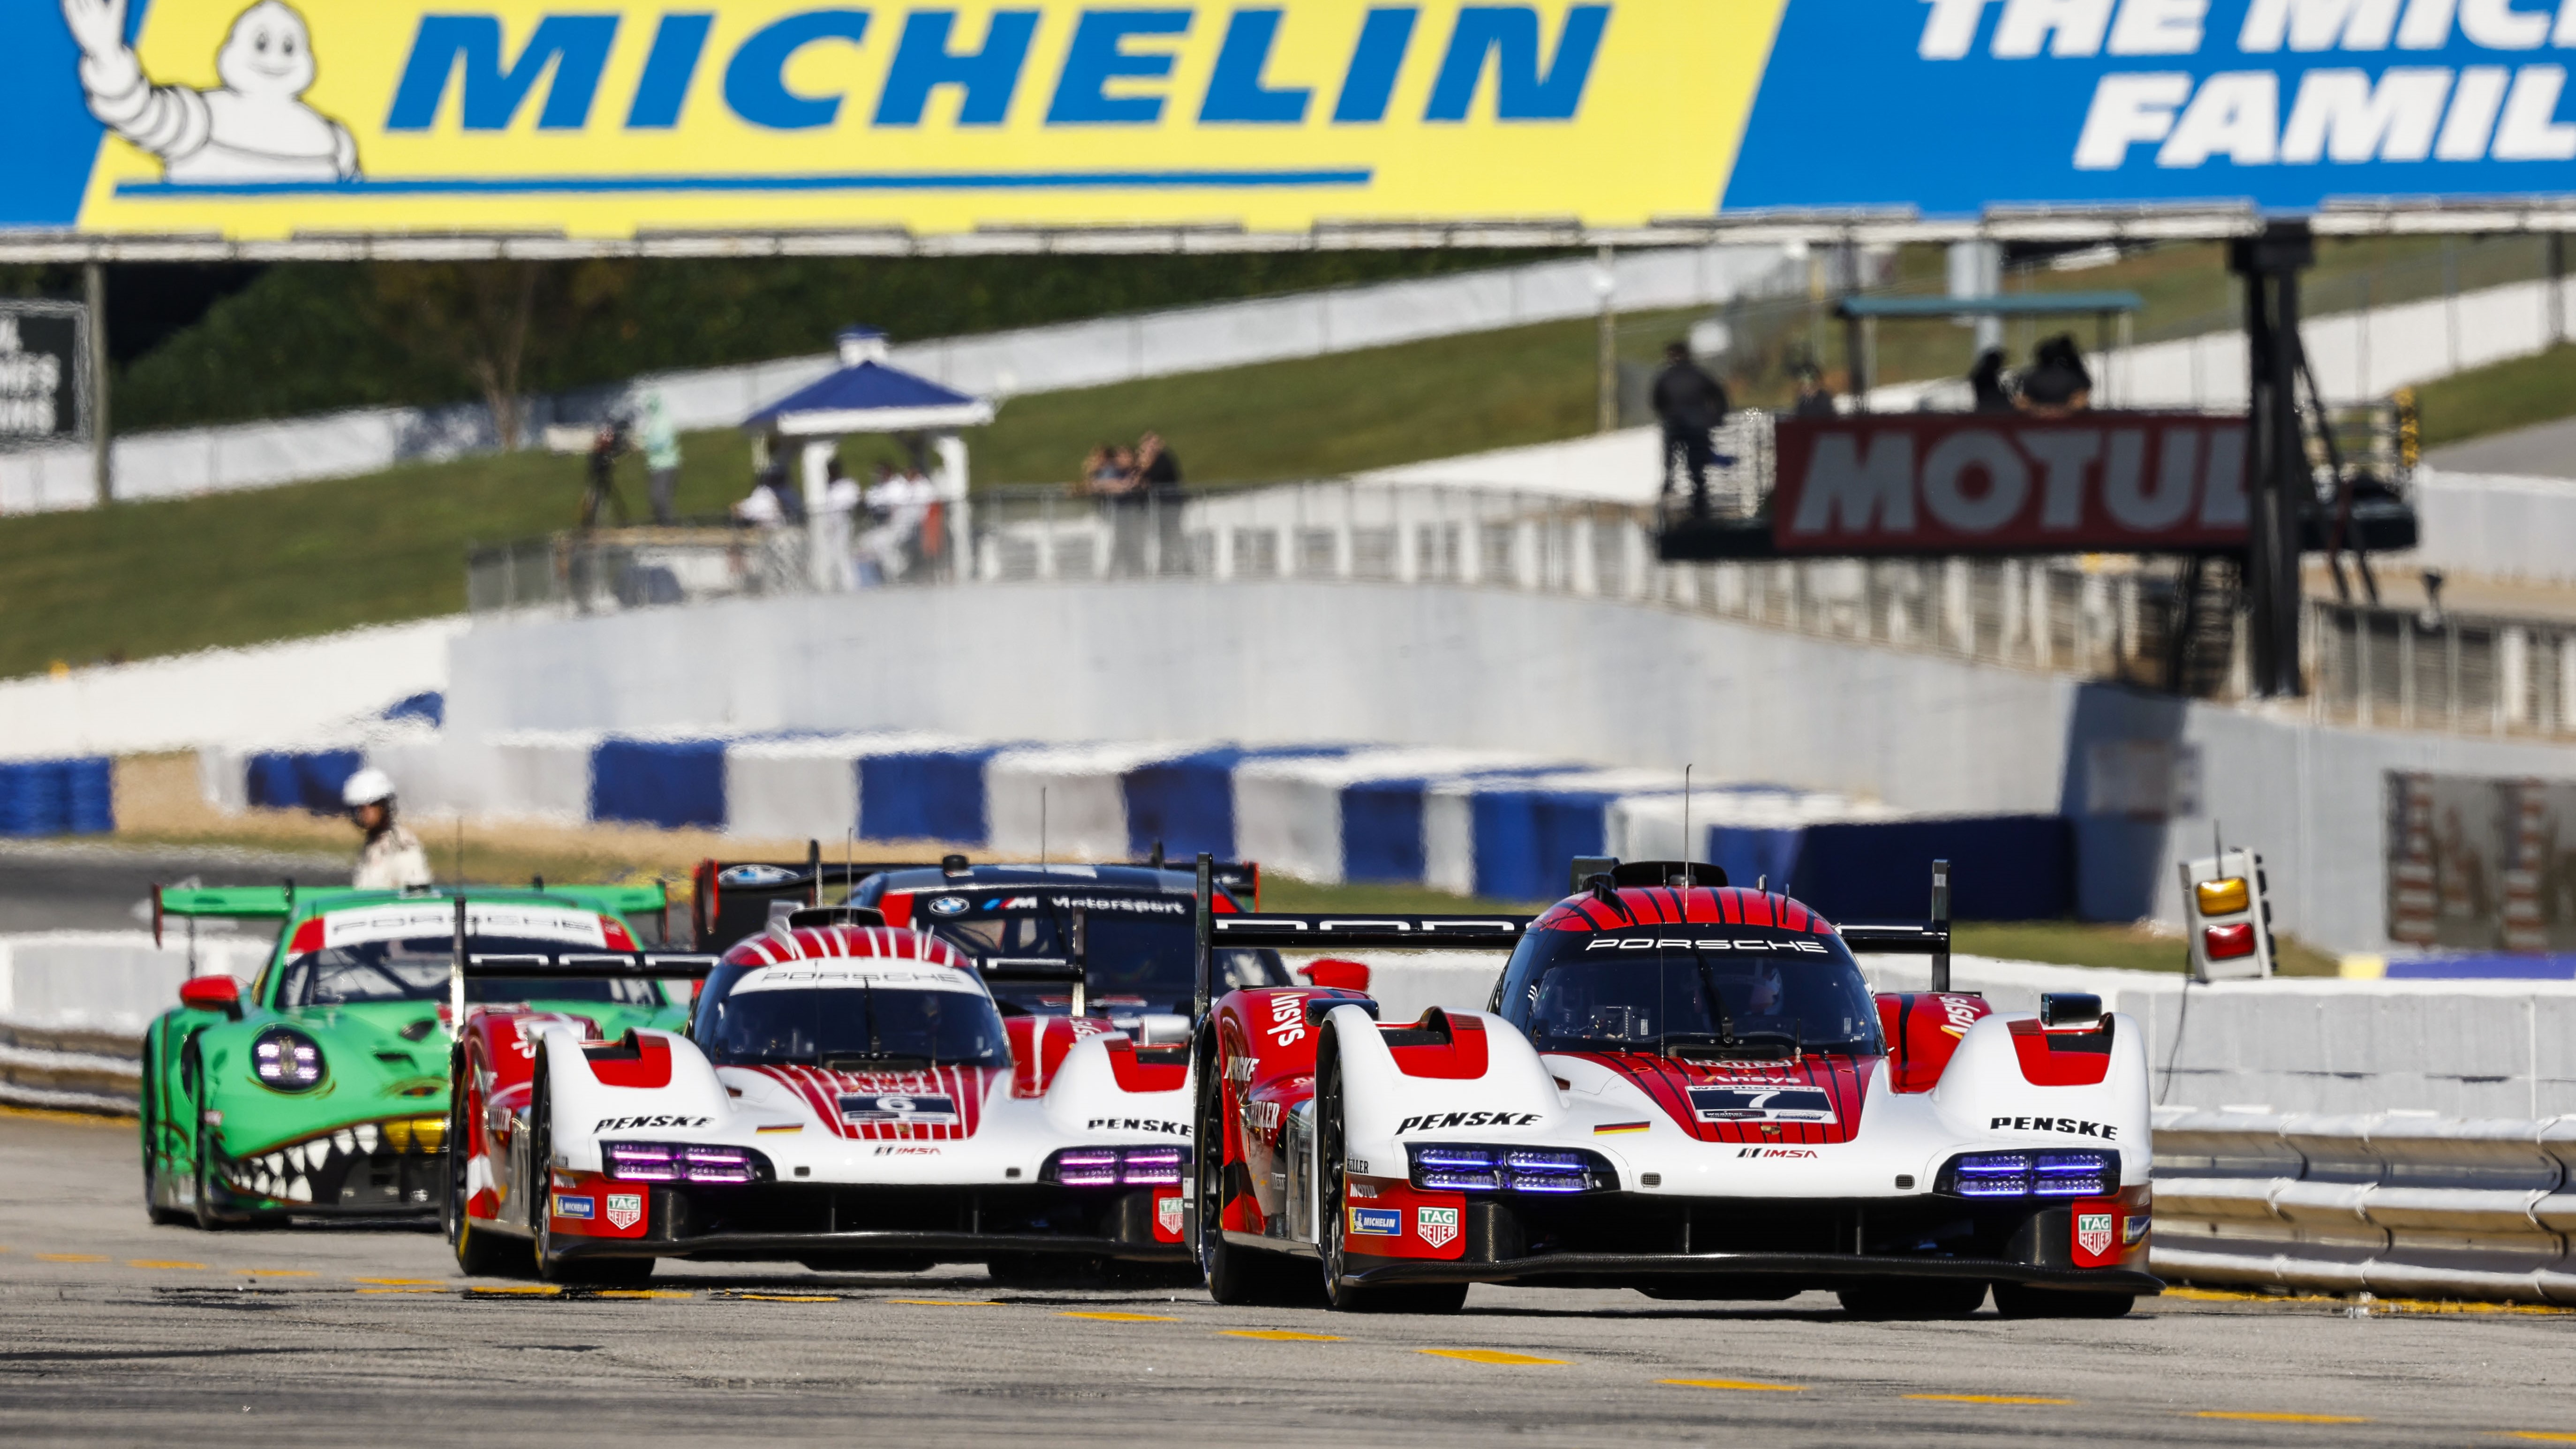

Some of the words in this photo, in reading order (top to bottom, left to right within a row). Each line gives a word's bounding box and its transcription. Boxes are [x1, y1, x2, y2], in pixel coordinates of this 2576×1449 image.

[1918, 0, 2212, 59] THE
[2236, 0, 2576, 53] MIC
[384, 4, 1610, 132] MICHELIN
[1586, 939, 1828, 953] PORSCHE
[762, 972, 964, 984] PORSCHE
[1267, 992, 1309, 1047] Ansys
[1703, 1075, 1801, 1084] Ansys
[876, 1096, 916, 1112] 6
[1733, 1090, 1781, 1108] 7
[592, 1116, 715, 1134] PENSKE
[1087, 1118, 1193, 1138] PENSKE
[1394, 1111, 1544, 1136] PENSKE
[1990, 1117, 2118, 1141] PENSKE
[1763, 1149, 1818, 1158] IMSA
[1346, 1158, 1369, 1174] HELLER
[1350, 1183, 1378, 1199] MOTUL
[564, 1201, 590, 1212] MICHELIN
[610, 1198, 639, 1209] TAG
[609, 1211, 639, 1225] HEUER
[1363, 1217, 1396, 1228] MICHELIN
[1421, 1210, 1454, 1223] TAG
[2082, 1217, 2109, 1230] TAG
[1420, 1225, 1455, 1245] HEUER
[2081, 1232, 2110, 1252] HEUER
